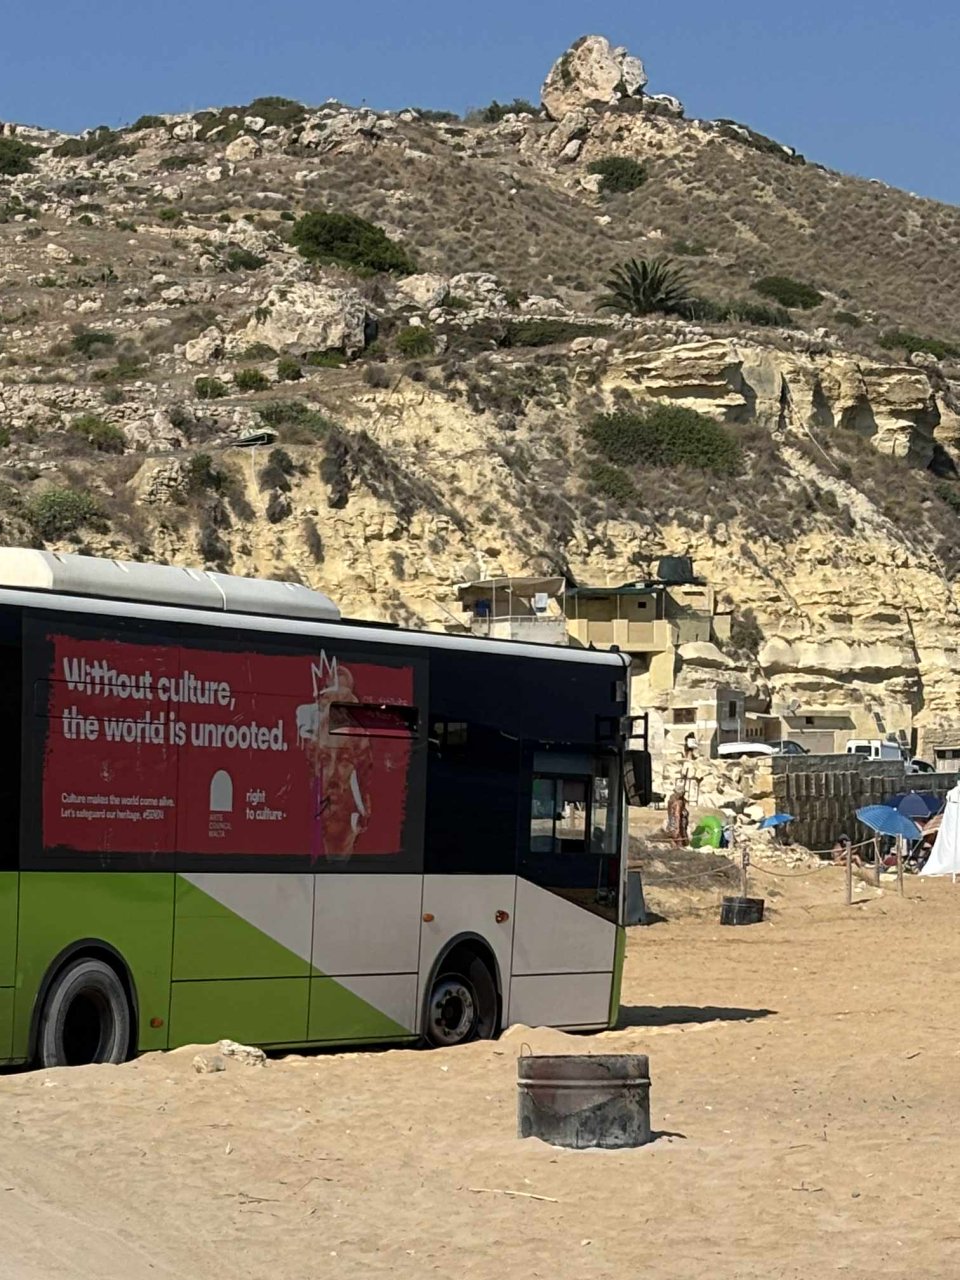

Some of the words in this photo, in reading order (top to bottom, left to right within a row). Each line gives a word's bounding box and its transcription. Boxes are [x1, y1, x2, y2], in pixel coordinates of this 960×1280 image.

[63, 657, 153, 698] Without
[157, 670, 236, 711] culture,
[62, 705, 99, 740] the
[104, 711, 164, 744] world
[169, 711, 187, 746] is
[190, 720, 288, 751] unrooted.
[61, 792, 86, 804] Culture
[87, 794, 109, 805] makes
[110, 795, 120, 805] the
[121, 795, 139, 806] world
[140, 797, 158, 806] come
[246, 789, 266, 806] right
[61, 808, 75, 818] Let's
[246, 807, 255, 820] to
